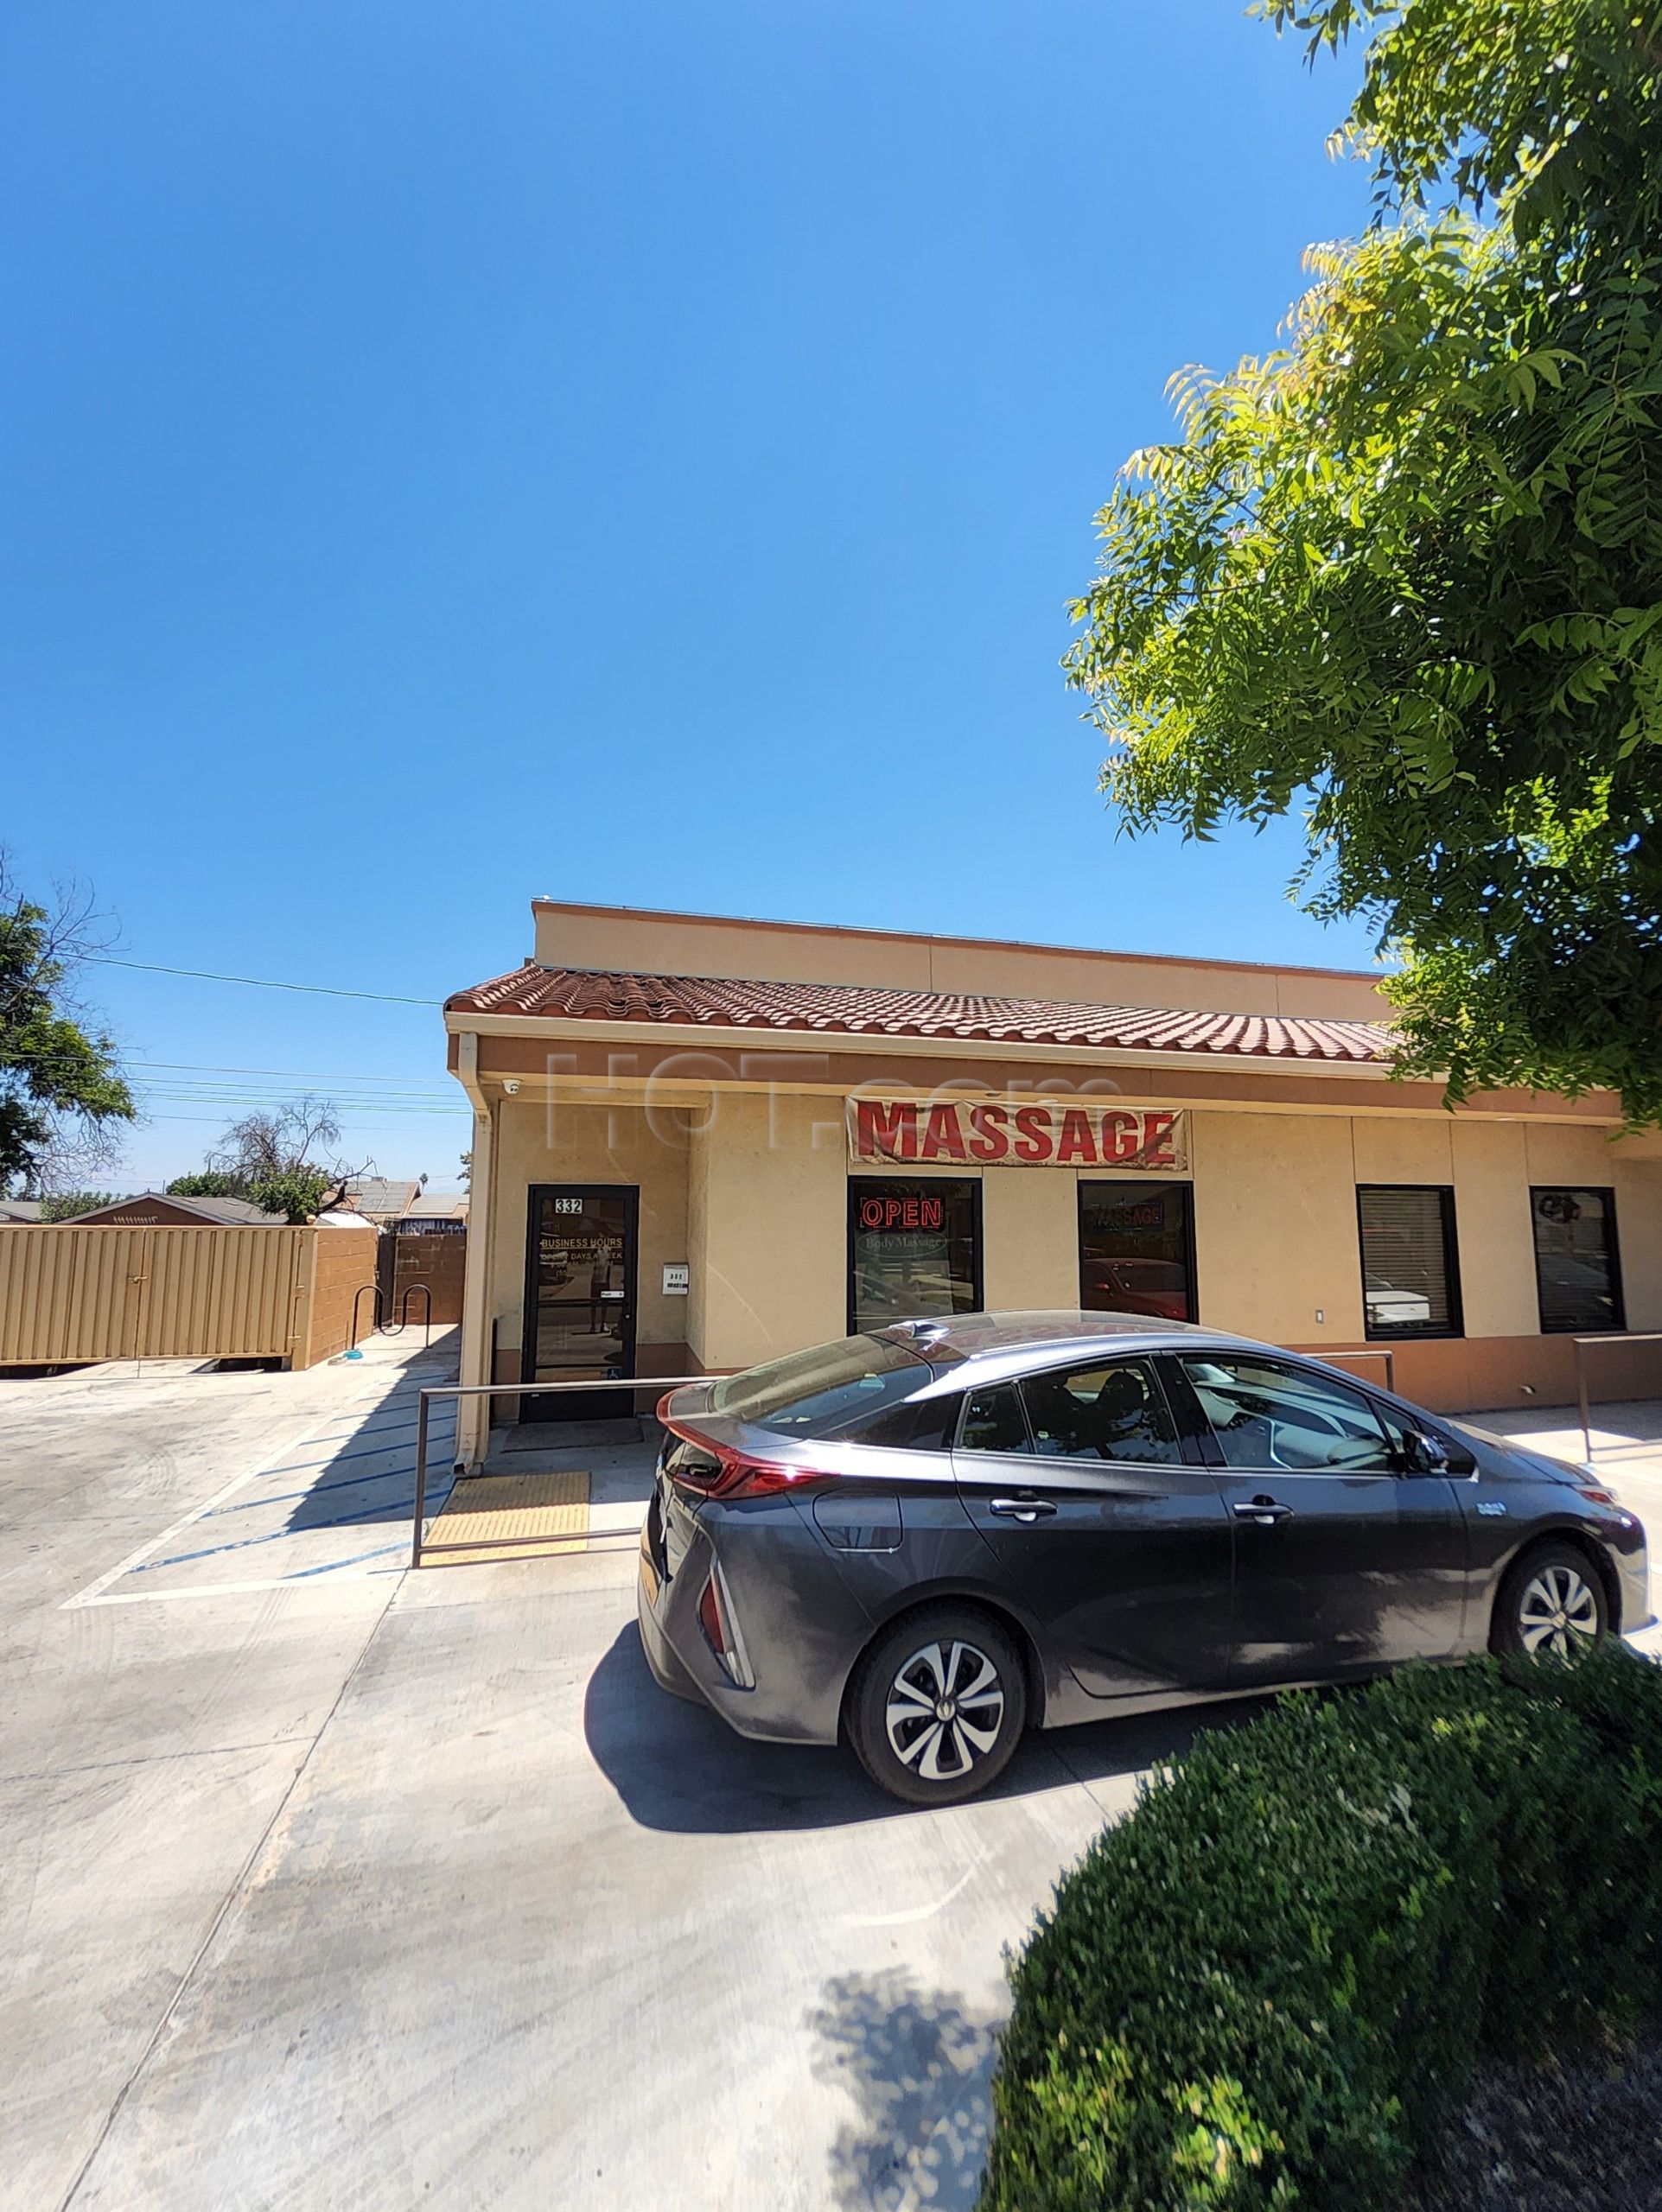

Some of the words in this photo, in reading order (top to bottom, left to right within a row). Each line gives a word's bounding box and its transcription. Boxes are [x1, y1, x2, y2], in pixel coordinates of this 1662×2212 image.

[856, 1100, 1176, 1165] MASSAGE
[556, 1199, 582, 1213] 332
[863, 1199, 941, 1226] OPEN
[541, 1237, 588, 1248] BUSINESS
[590, 1236, 622, 1247] HOURS
[865, 1236, 893, 1251] Body
[895, 1236, 941, 1249] Massage
